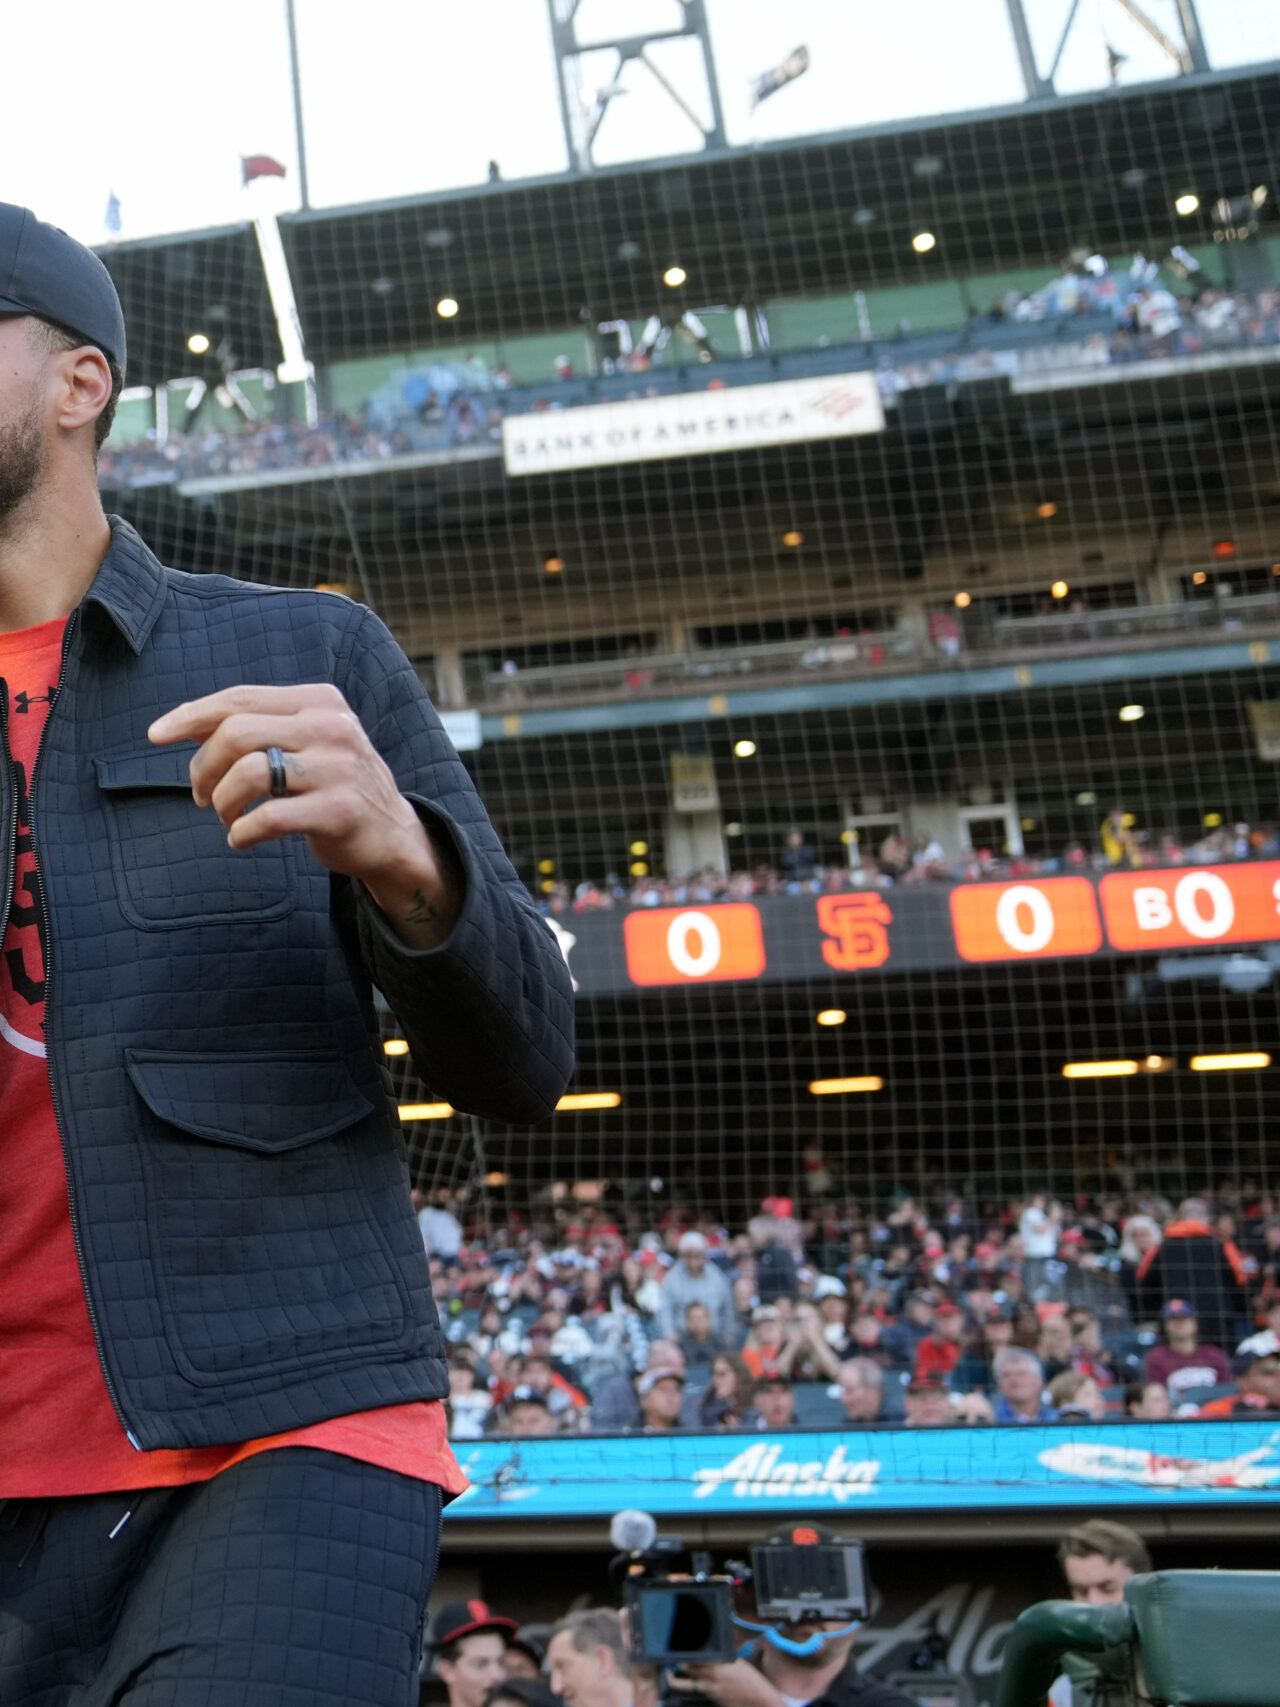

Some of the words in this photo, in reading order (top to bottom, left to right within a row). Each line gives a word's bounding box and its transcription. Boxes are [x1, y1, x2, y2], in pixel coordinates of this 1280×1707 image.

[513, 433, 593, 455] BANK
[606, 424, 641, 446] OF
[654, 408, 795, 440] AMERICA
[667, 911, 721, 977] 0
[995, 885, 1055, 953] 0
[693, 1442, 881, 1502] Alaska
